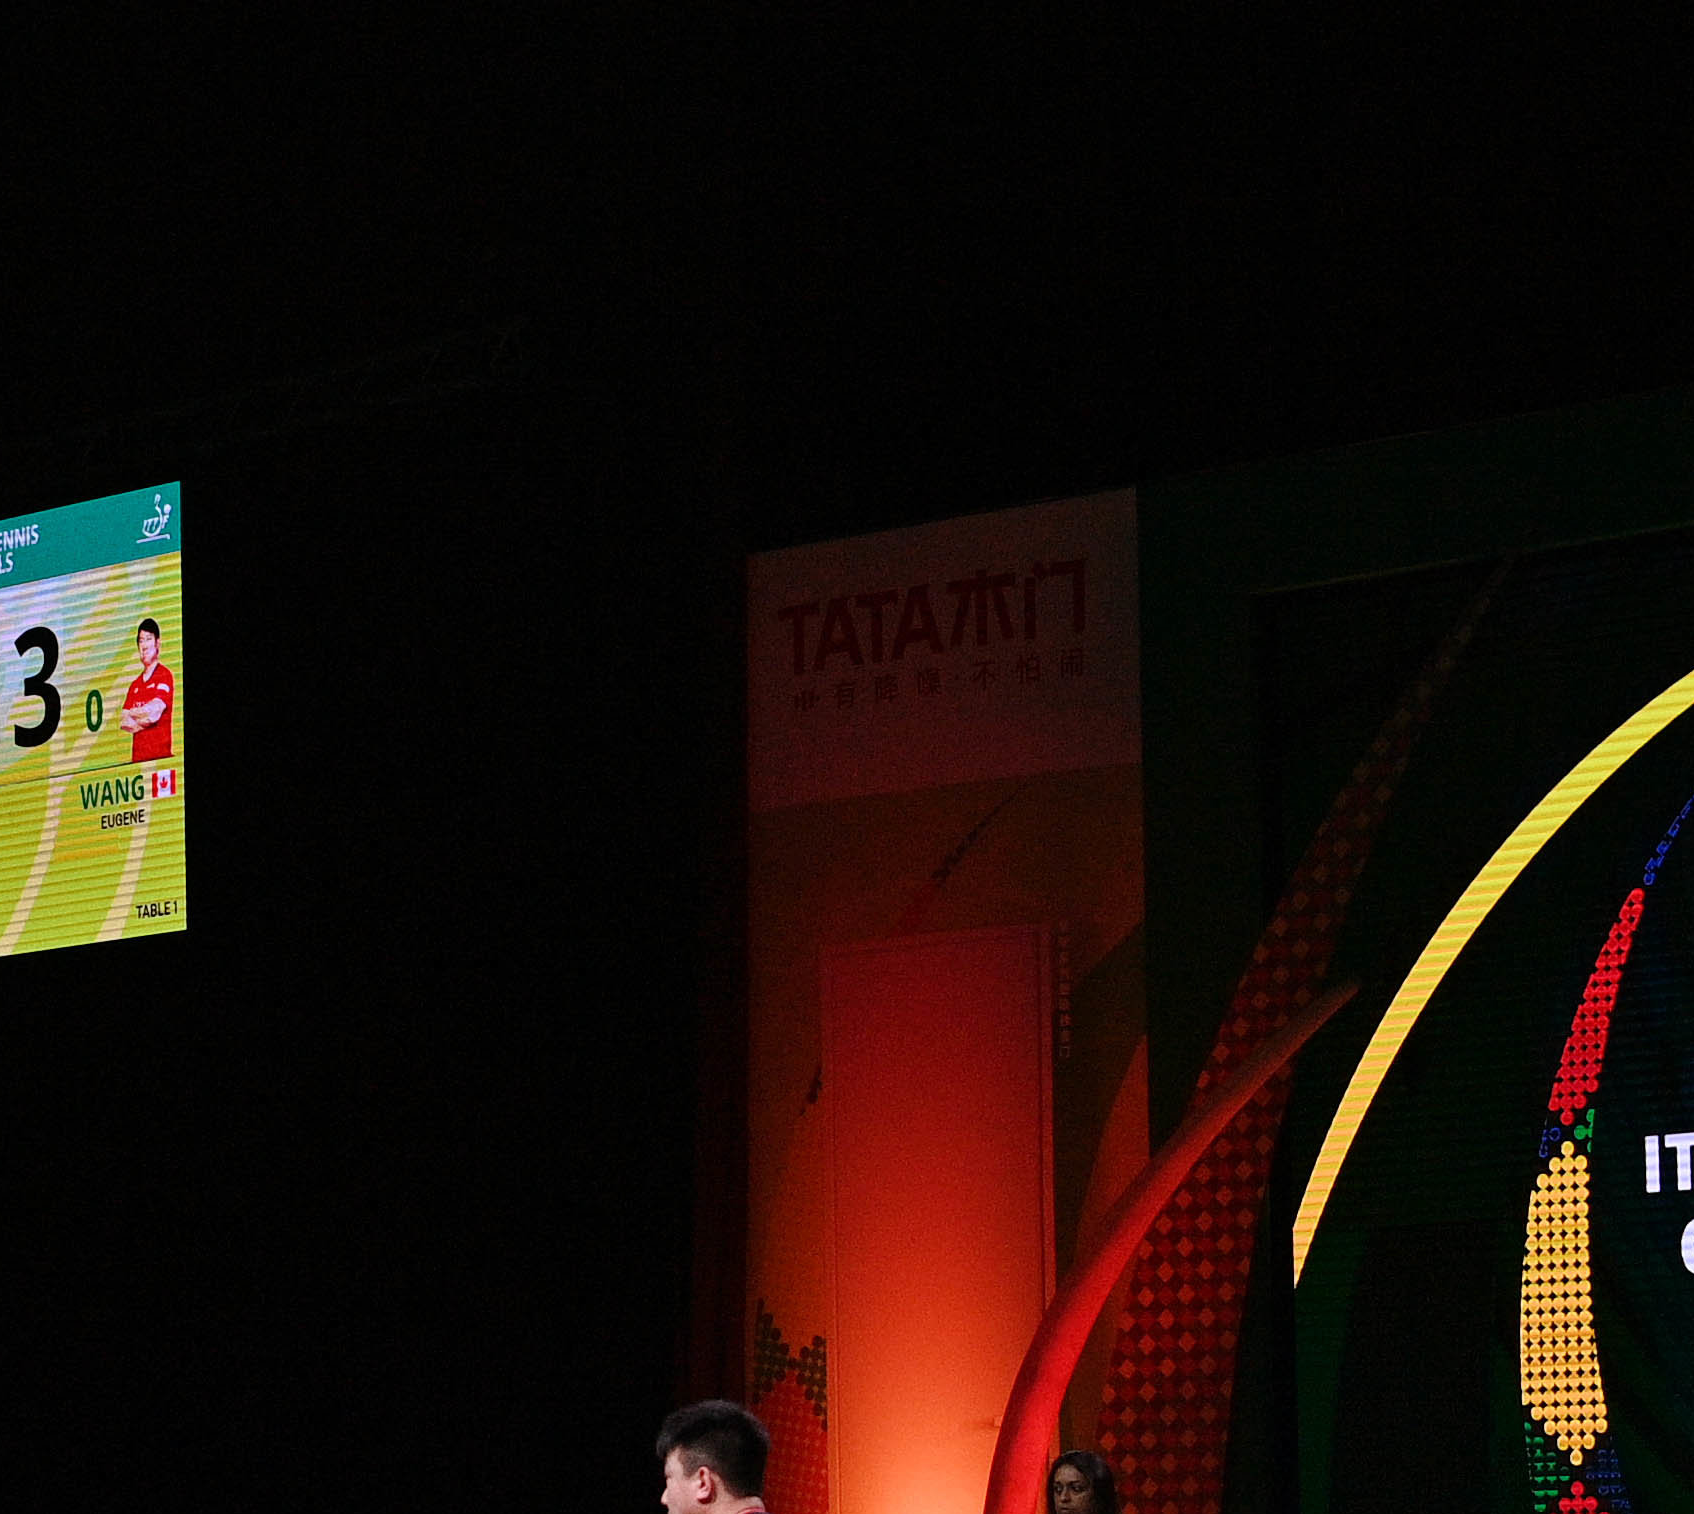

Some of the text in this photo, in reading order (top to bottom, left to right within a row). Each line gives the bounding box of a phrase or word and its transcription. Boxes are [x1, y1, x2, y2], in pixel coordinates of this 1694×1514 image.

[85, 689, 103, 732] 0
[81, 774, 145, 811] WANG
[100, 809, 145, 830] EUGENE
[136, 902, 171, 919] TABLE
